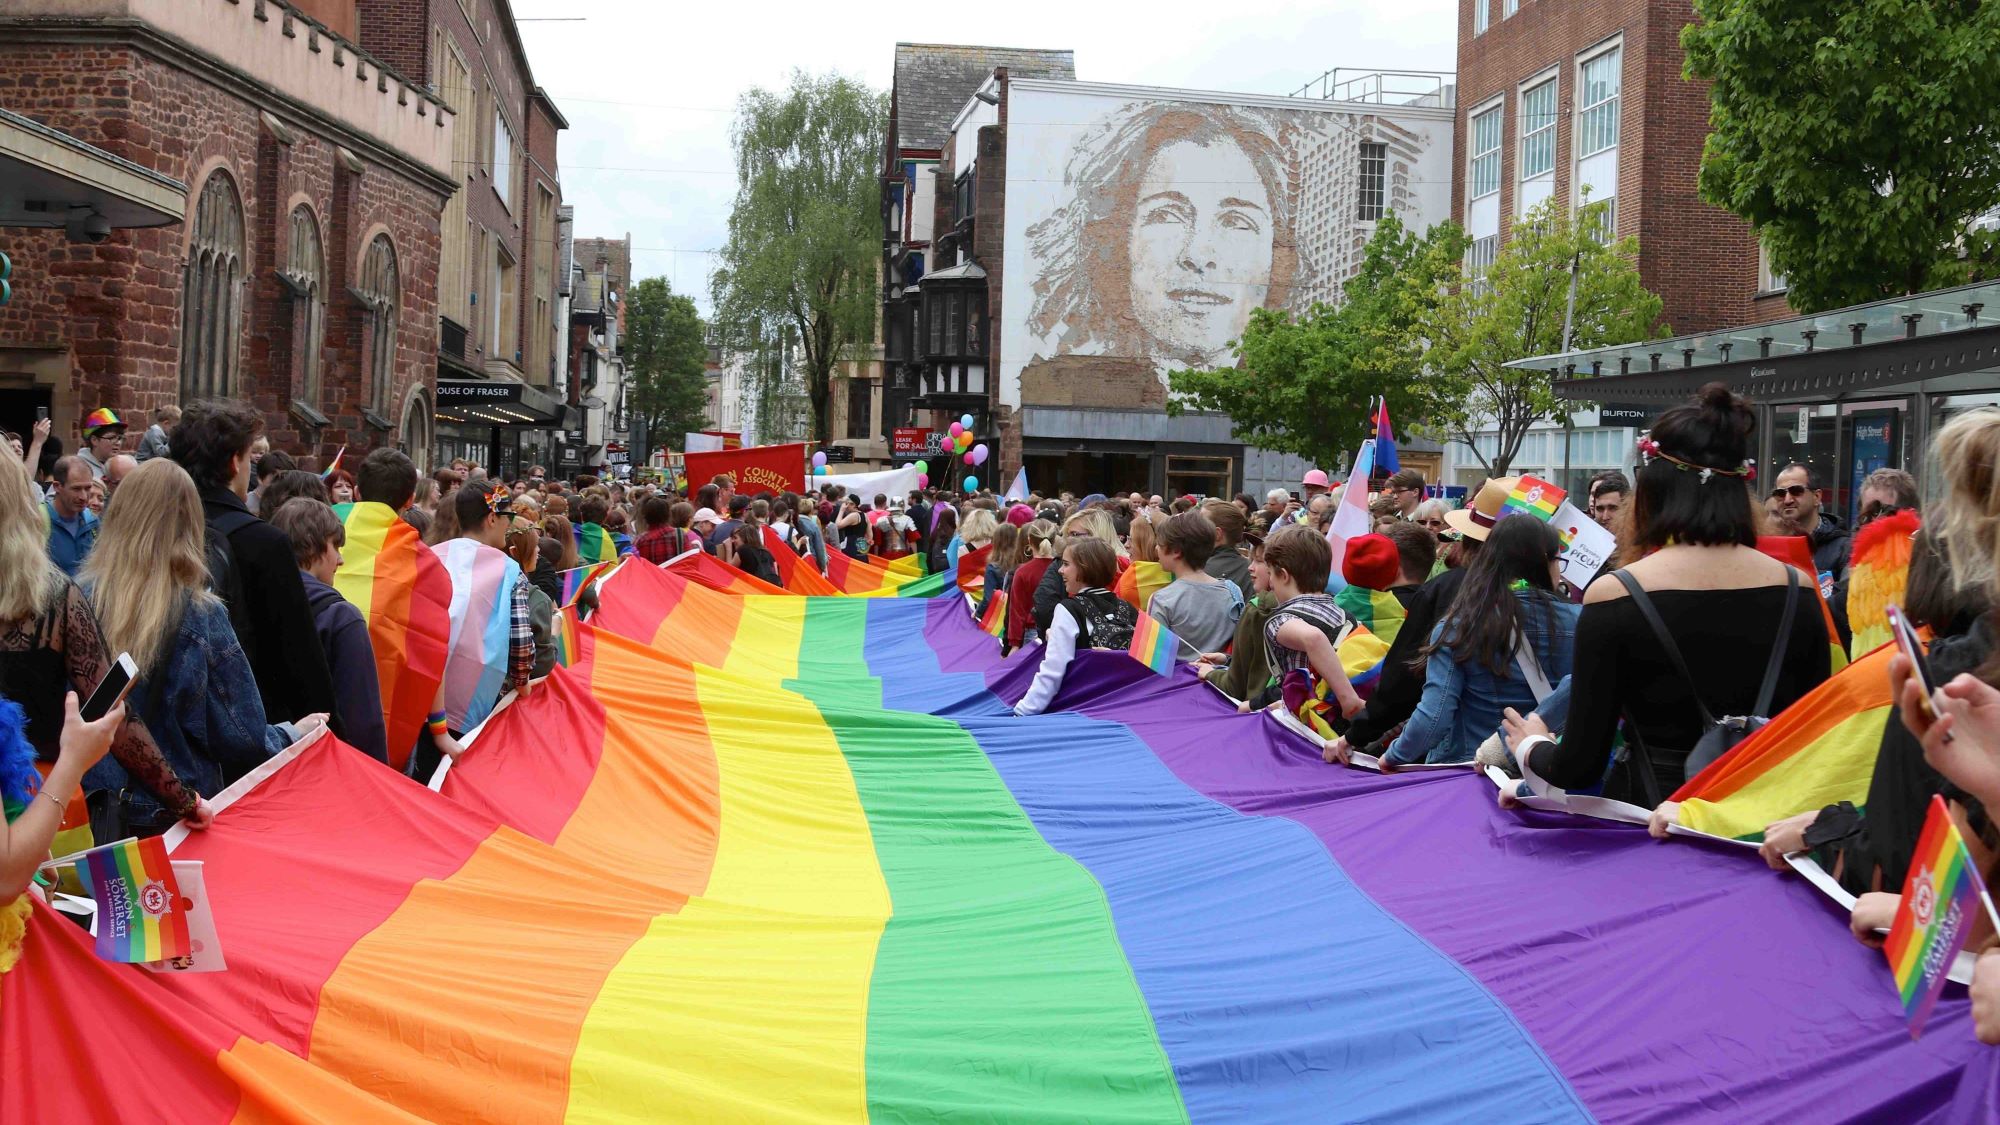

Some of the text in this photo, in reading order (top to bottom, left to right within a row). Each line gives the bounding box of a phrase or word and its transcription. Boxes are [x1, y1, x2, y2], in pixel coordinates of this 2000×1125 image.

[437, 387, 509, 396] OUSE OF FRASER
[927, 432, 947, 441] URBA
[608, 451, 629, 463] VINTAGE
[743, 476, 786, 497] ASSOCIATIO
[744, 466, 791, 488] COUNTY
[1570, 549, 1600, 569] proud
[109, 878, 126, 939] SOMERSET
[117, 877, 135, 920] DEVON
